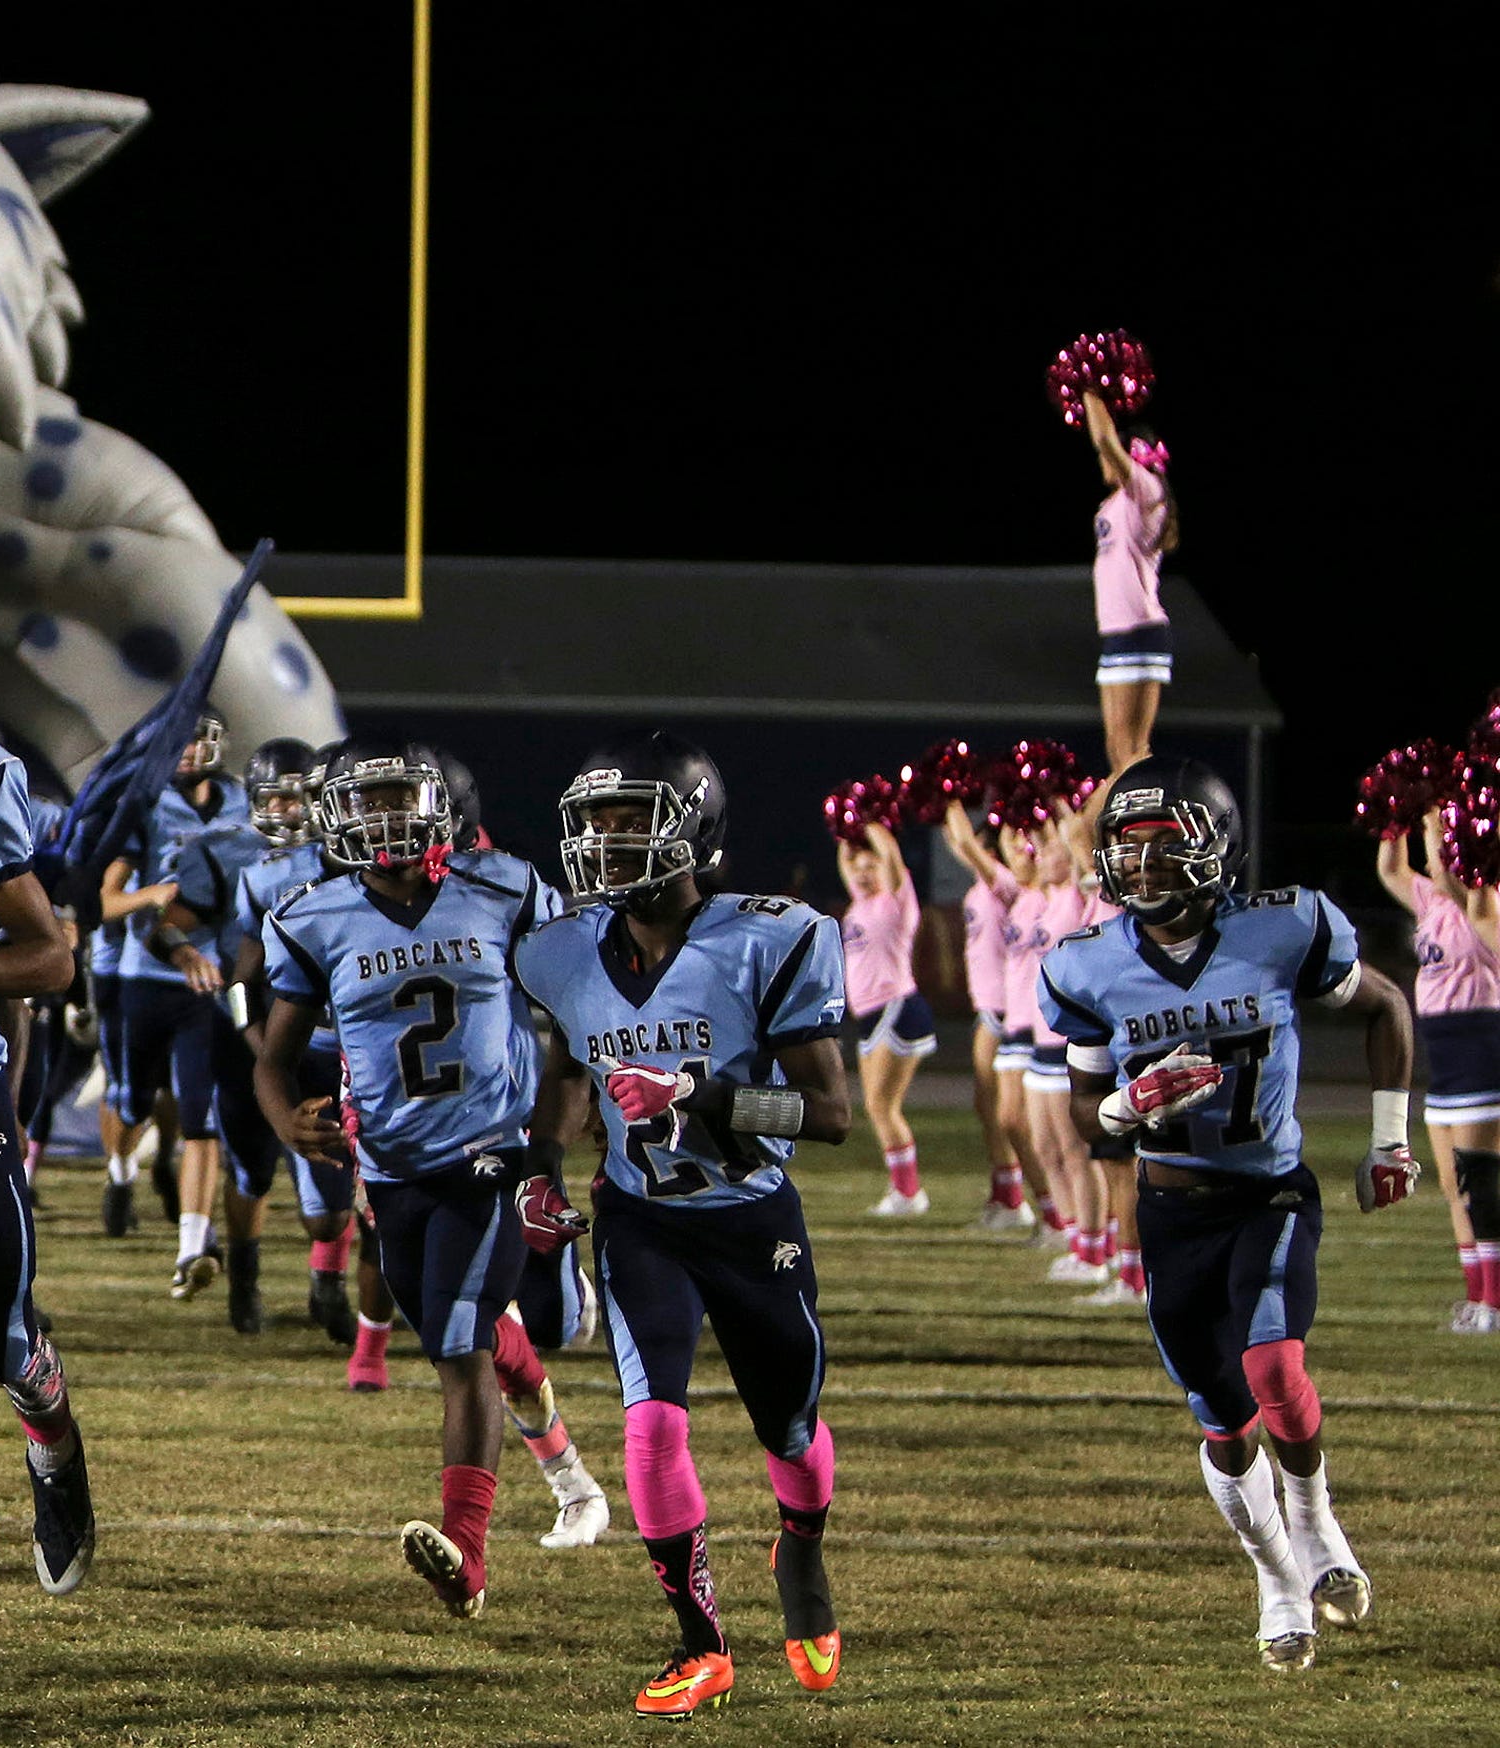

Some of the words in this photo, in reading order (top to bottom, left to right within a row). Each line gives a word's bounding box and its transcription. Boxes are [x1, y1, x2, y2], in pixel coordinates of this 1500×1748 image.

[356, 937, 483, 980] BOBCATS
[393, 974, 466, 1101] 2
[587, 1018, 713, 1065] BOBCATS
[1124, 993, 1263, 1045] BOBCATS
